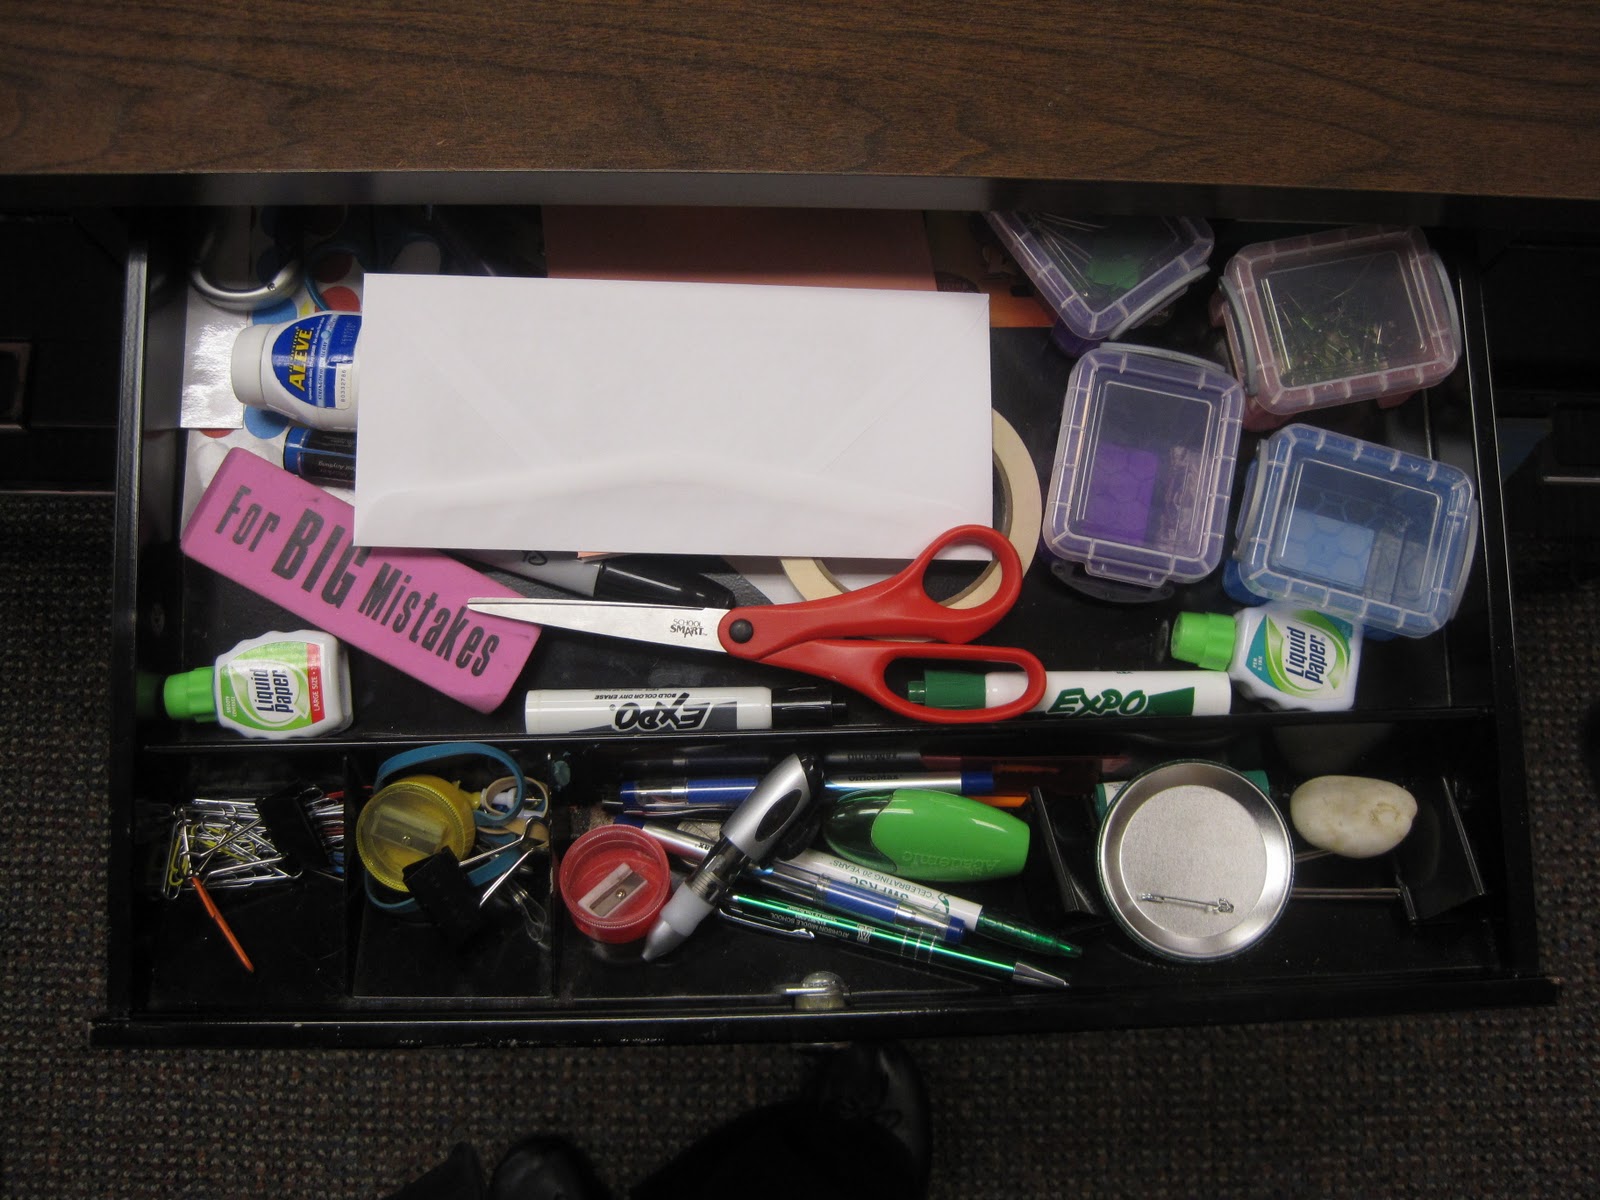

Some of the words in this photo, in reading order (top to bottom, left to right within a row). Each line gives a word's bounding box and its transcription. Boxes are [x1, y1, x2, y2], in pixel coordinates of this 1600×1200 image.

[289, 328, 313, 392] ALEVE
[215, 485, 280, 552] For
[271, 508, 371, 609] BIG
[358, 562, 500, 677] Mistakes
[670, 624, 703, 638] SMART
[673, 618, 701, 626] SCHOOL
[1285, 626, 1308, 677] Liquid
[250, 668, 275, 712] Liquid
[313, 691, 321, 712] LARGE
[1046, 687, 1148, 716] EXPO
[614, 692, 711, 730] EXPO
[863, 869, 871, 877] 20
[771, 912, 795, 924] SCHOOL
[797, 919, 818, 930] MIDDLE
